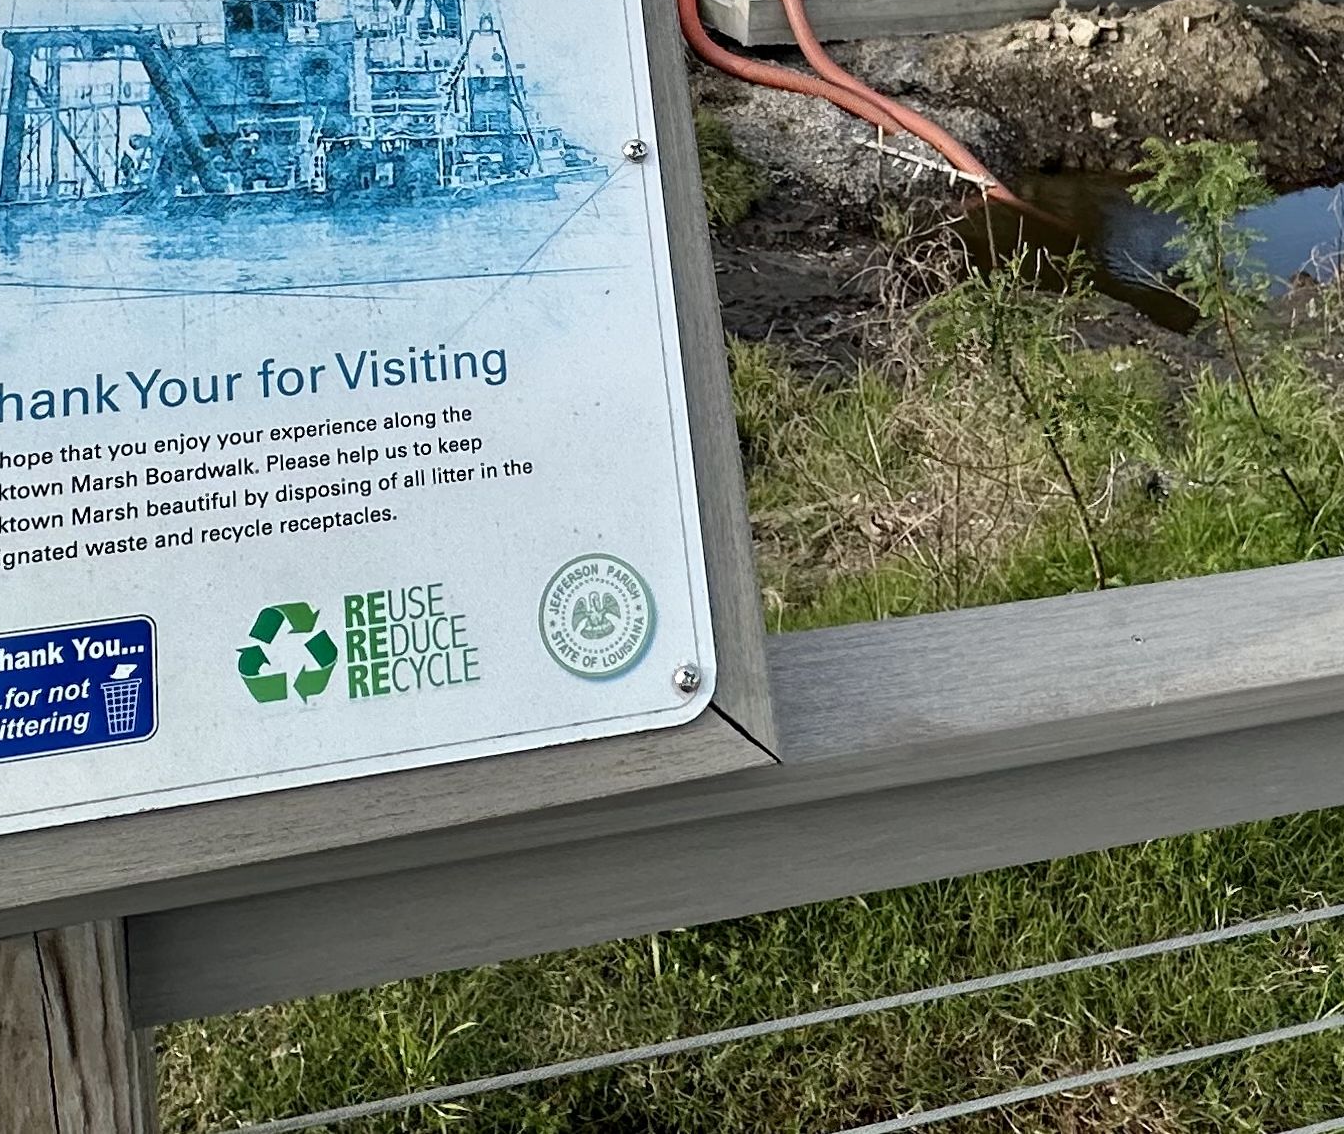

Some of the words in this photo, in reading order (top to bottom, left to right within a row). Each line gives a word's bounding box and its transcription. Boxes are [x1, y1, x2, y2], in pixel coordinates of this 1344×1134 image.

[126, 368, 243, 411] Your
[258, 359, 326, 399] for
[335, 343, 509, 391] Visiting
[0, 450, 54, 471] hope
[59, 443, 103, 463] that
[107, 441, 147, 462] you
[154, 432, 212, 455] enjoy
[216, 429, 264, 451] your
[269, 418, 378, 443] experience
[383, 411, 437, 430] along
[441, 405, 472, 424] the
[71, 470, 138, 494] Marsh
[145, 457, 260, 486] Boardwalk.
[266, 453, 331, 473] Please
[336, 445, 379, 466] help
[385, 445, 408, 460] us
[412, 441, 432, 457] to
[437, 436, 483, 455] keep
[71, 501, 139, 526] Marsh
[146, 489, 237, 518] beautiful
[244, 488, 269, 509] by
[275, 477, 372, 504] disposing
[377, 471, 398, 491] of
[403, 468, 426, 489] all
[431, 466, 475, 485] litter
[479, 462, 498, 480] in
[502, 458, 533, 477] the
[84, 535, 148, 557] waste
[154, 526, 194, 549] and
[201, 518, 273, 544] recycle
[279, 505, 398, 534] receptacles.
[344, 583, 445, 628] REUSE
[549, 564, 599, 615] JEFFERSON
[607, 566, 641, 601] PARISH
[72, 637, 145, 662] You...
[346, 614, 468, 664] REDUCE
[551, 630, 580, 663] STATE
[582, 655, 598, 668] OF
[603, 616, 645, 667] LOUISIANA
[48, 678, 91, 704] not
[347, 647, 481, 699] RECYCLE
